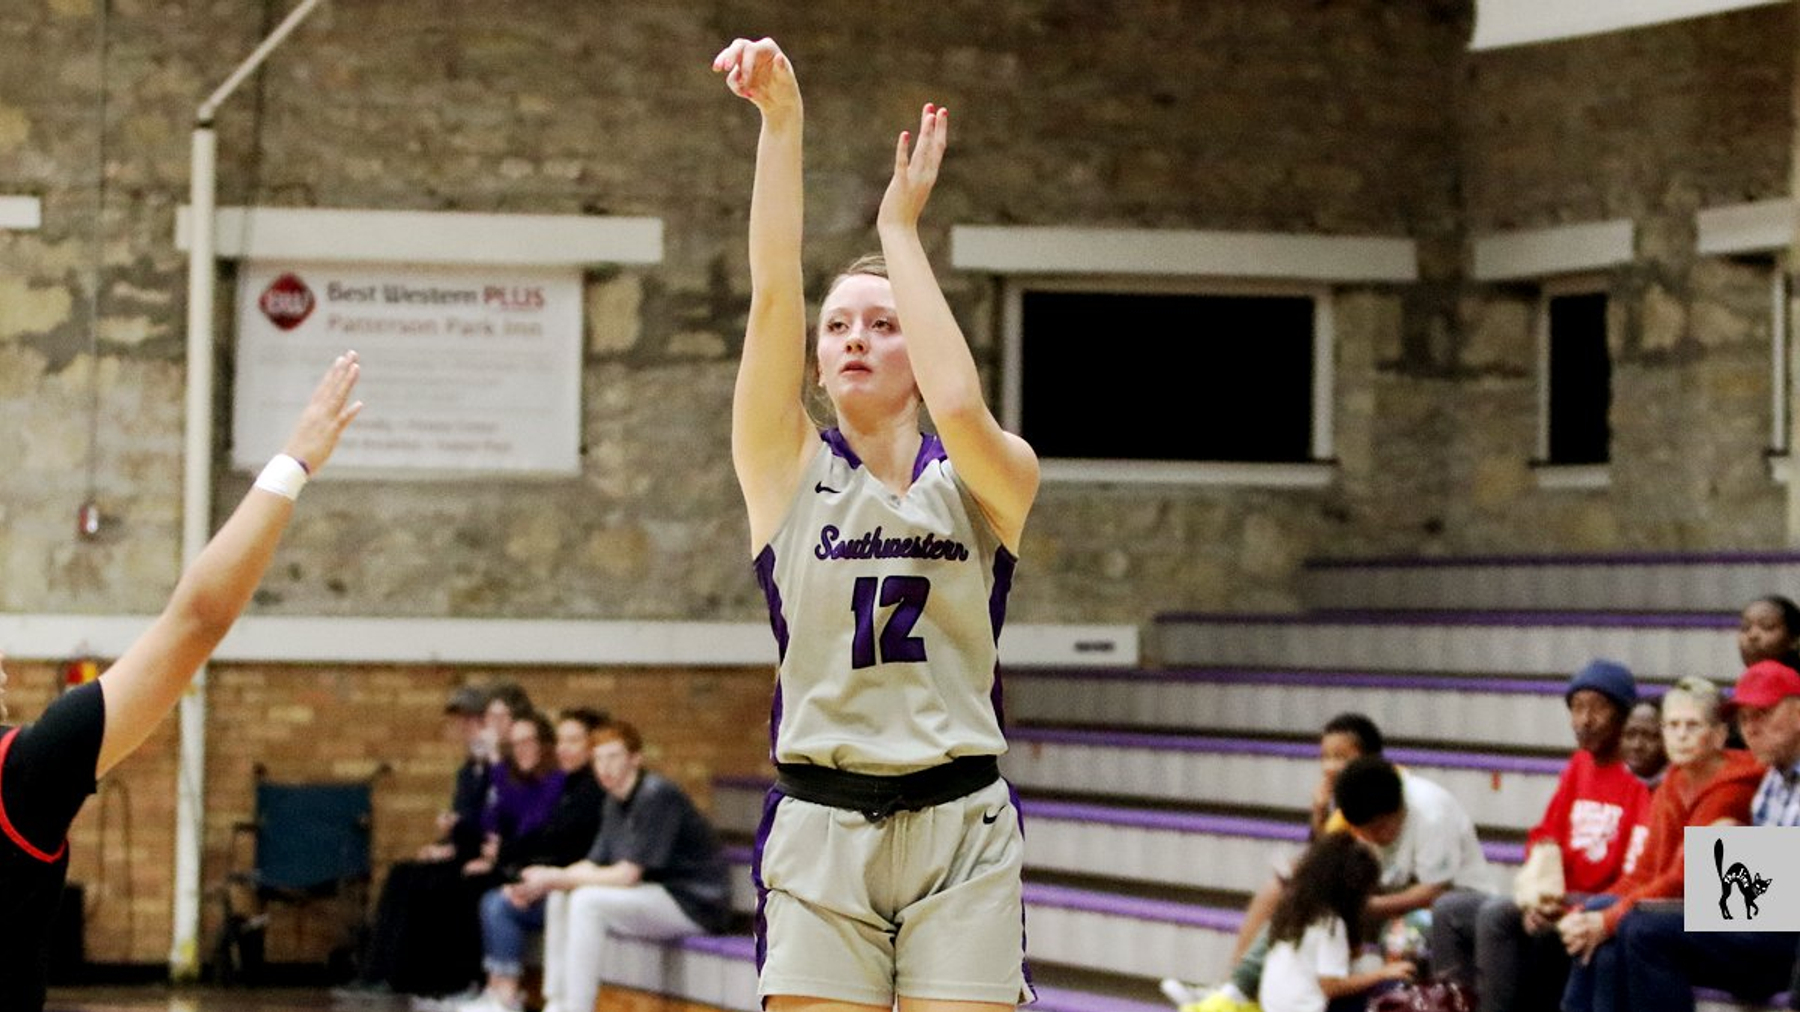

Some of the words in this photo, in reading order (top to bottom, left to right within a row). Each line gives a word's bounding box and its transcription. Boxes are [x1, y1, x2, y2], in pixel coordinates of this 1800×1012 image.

[327, 281, 376, 302] Best
[383, 284, 477, 304] Western
[484, 285, 545, 308] PLUS
[445, 316, 495, 335] Park
[814, 525, 969, 561] Southwestern
[851, 575, 931, 669] 12
